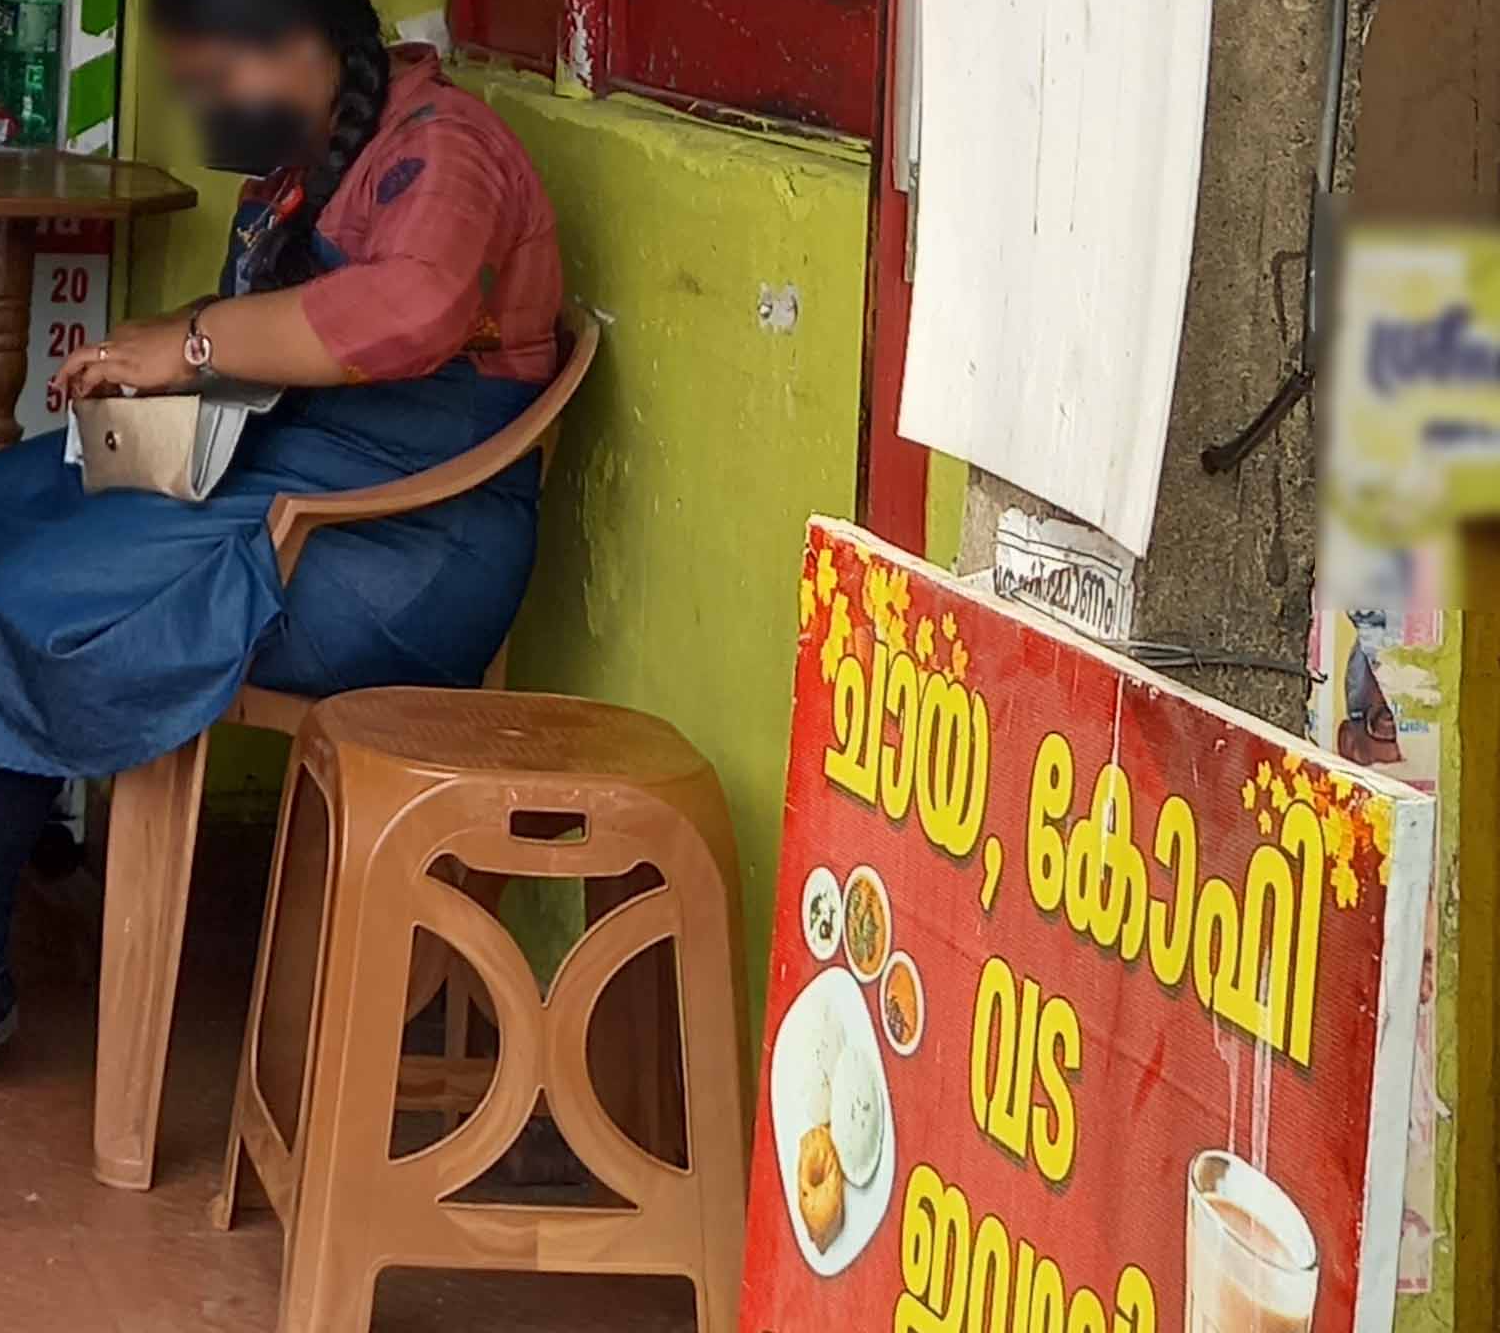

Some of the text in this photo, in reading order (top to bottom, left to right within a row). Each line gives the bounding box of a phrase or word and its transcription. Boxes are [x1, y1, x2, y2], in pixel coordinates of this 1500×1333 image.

[48, 322, 87, 358] 20
[50, 266, 90, 304] 20
[824, 641, 1326, 1070] ചായ, കോഫി
[970, 954, 1083, 1184] വട
